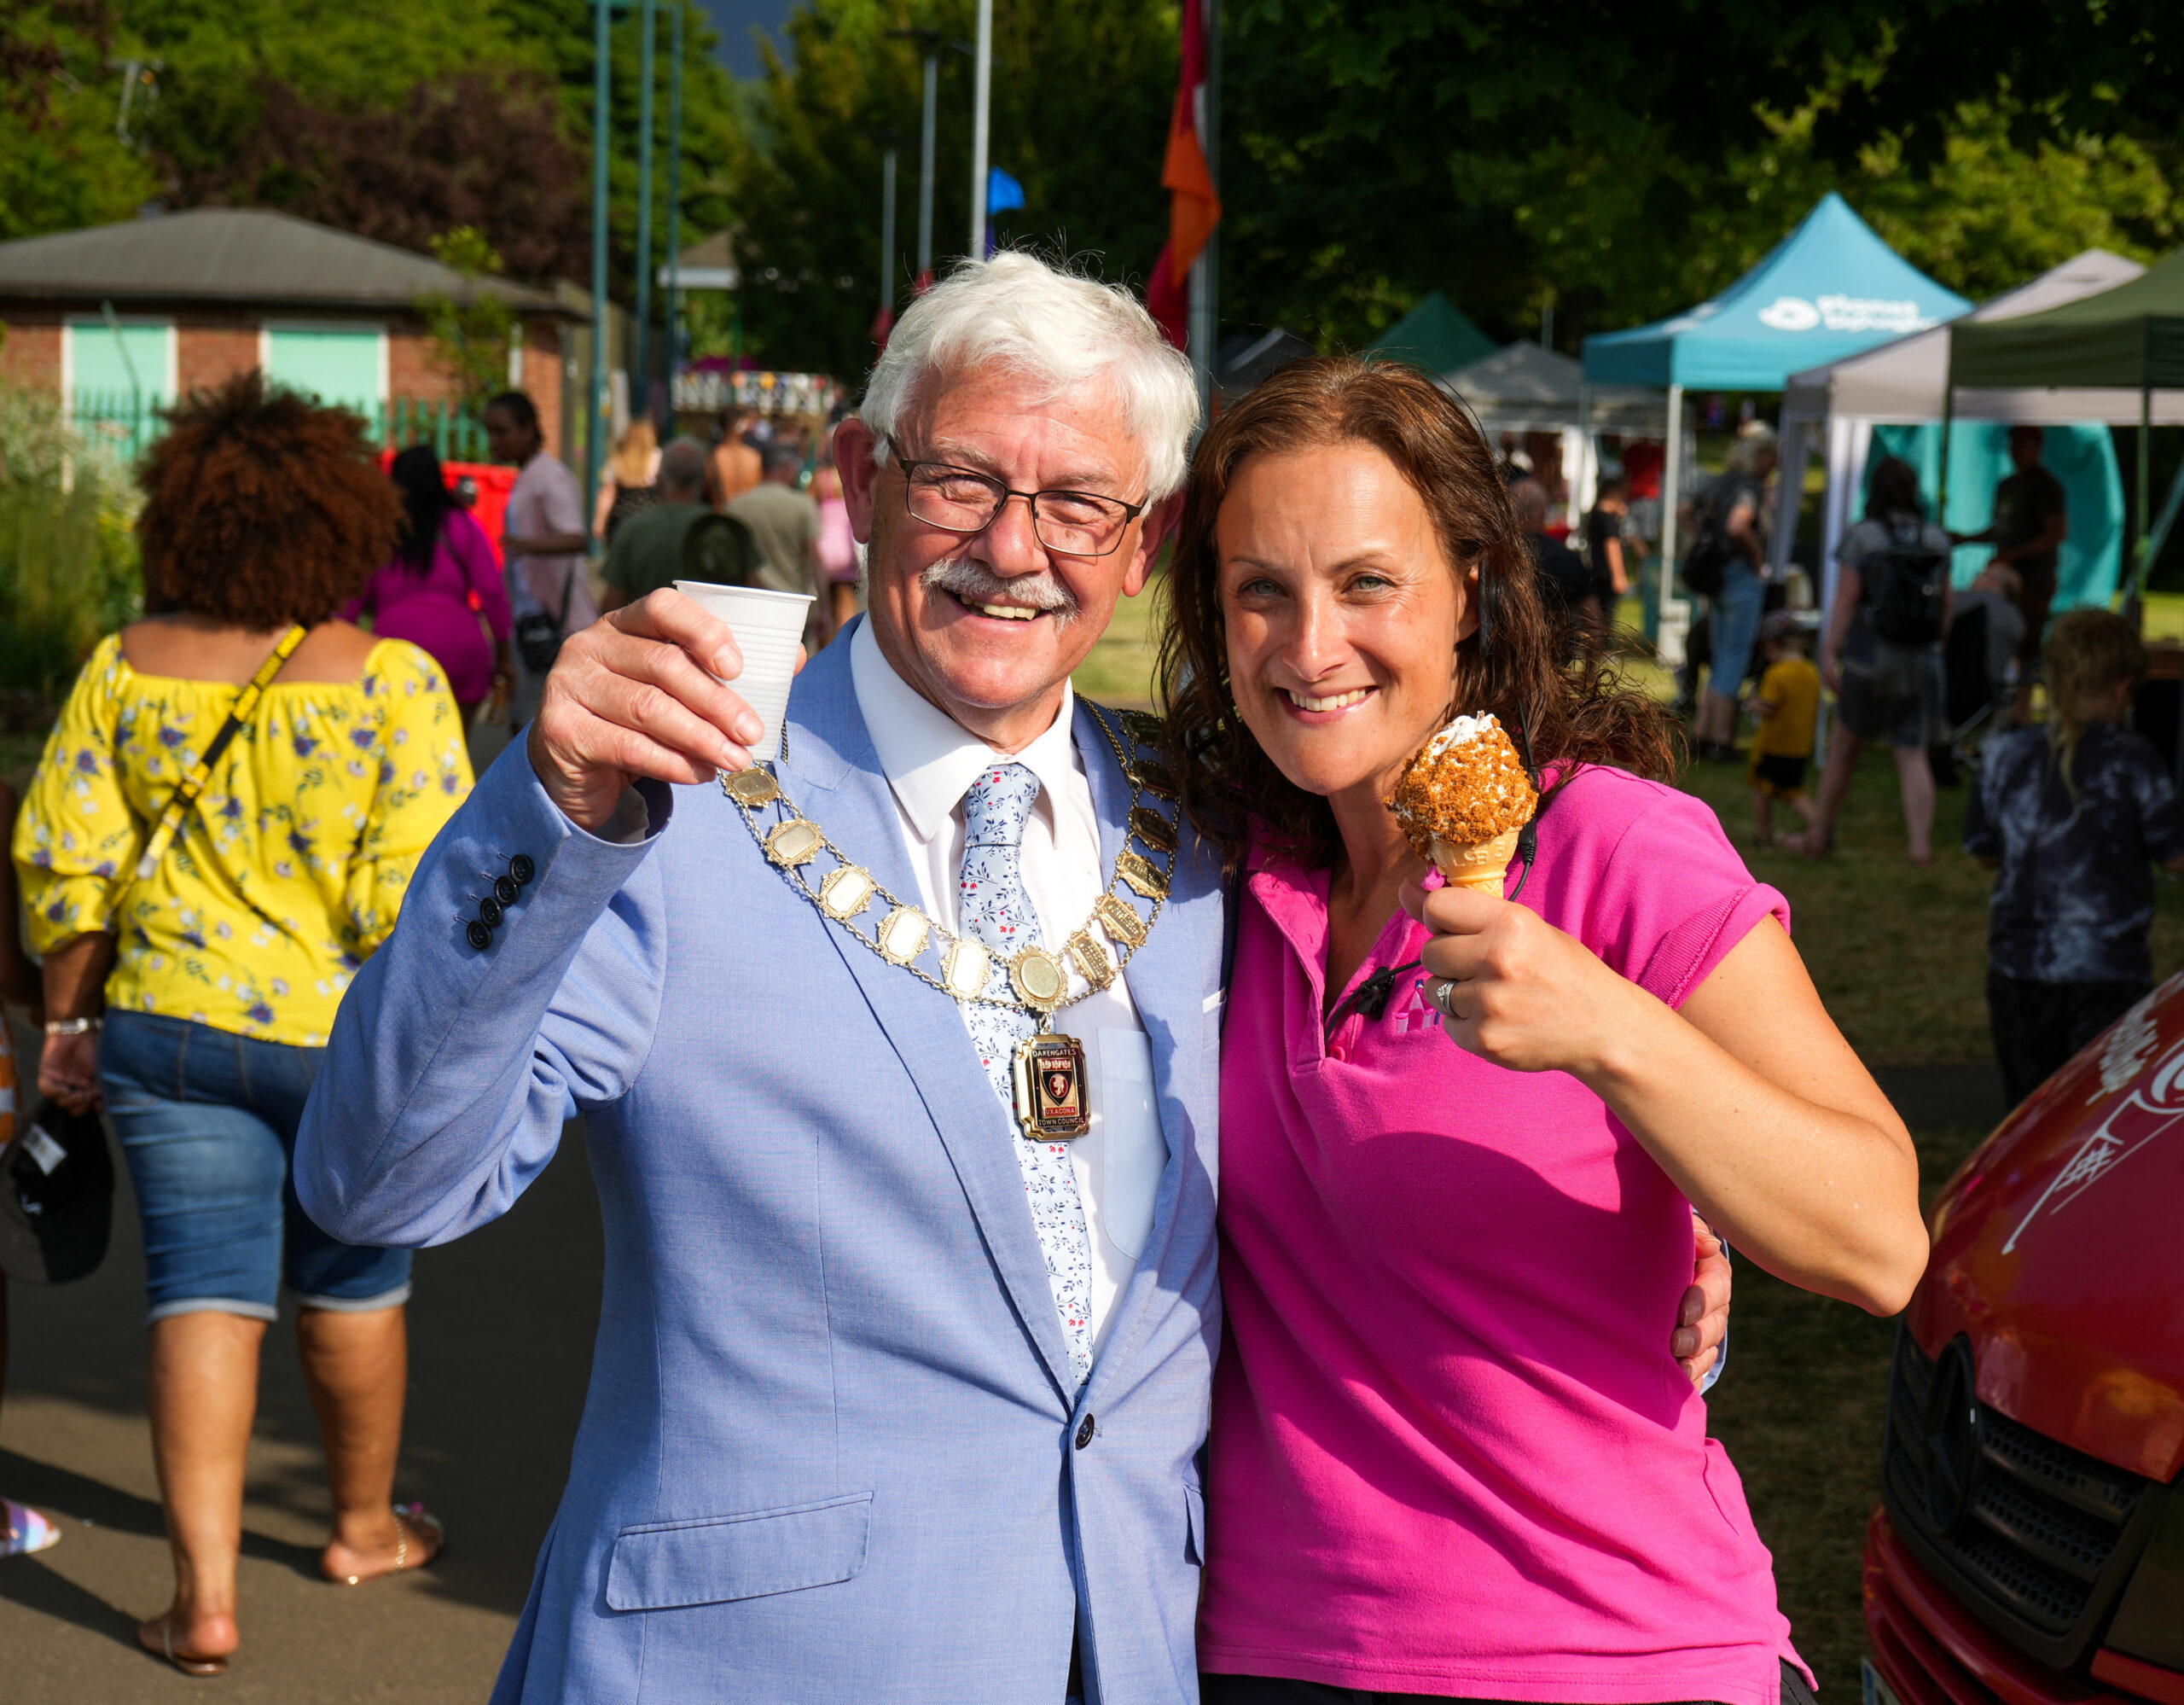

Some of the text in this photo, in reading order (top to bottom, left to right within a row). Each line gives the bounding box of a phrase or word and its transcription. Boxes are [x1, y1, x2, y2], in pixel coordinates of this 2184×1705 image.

[1032, 1049, 1077, 1057] OAKENGATES
[1046, 1107, 1076, 1115] UXACONA
[1058, 1117, 1084, 1126] COUNCIL
